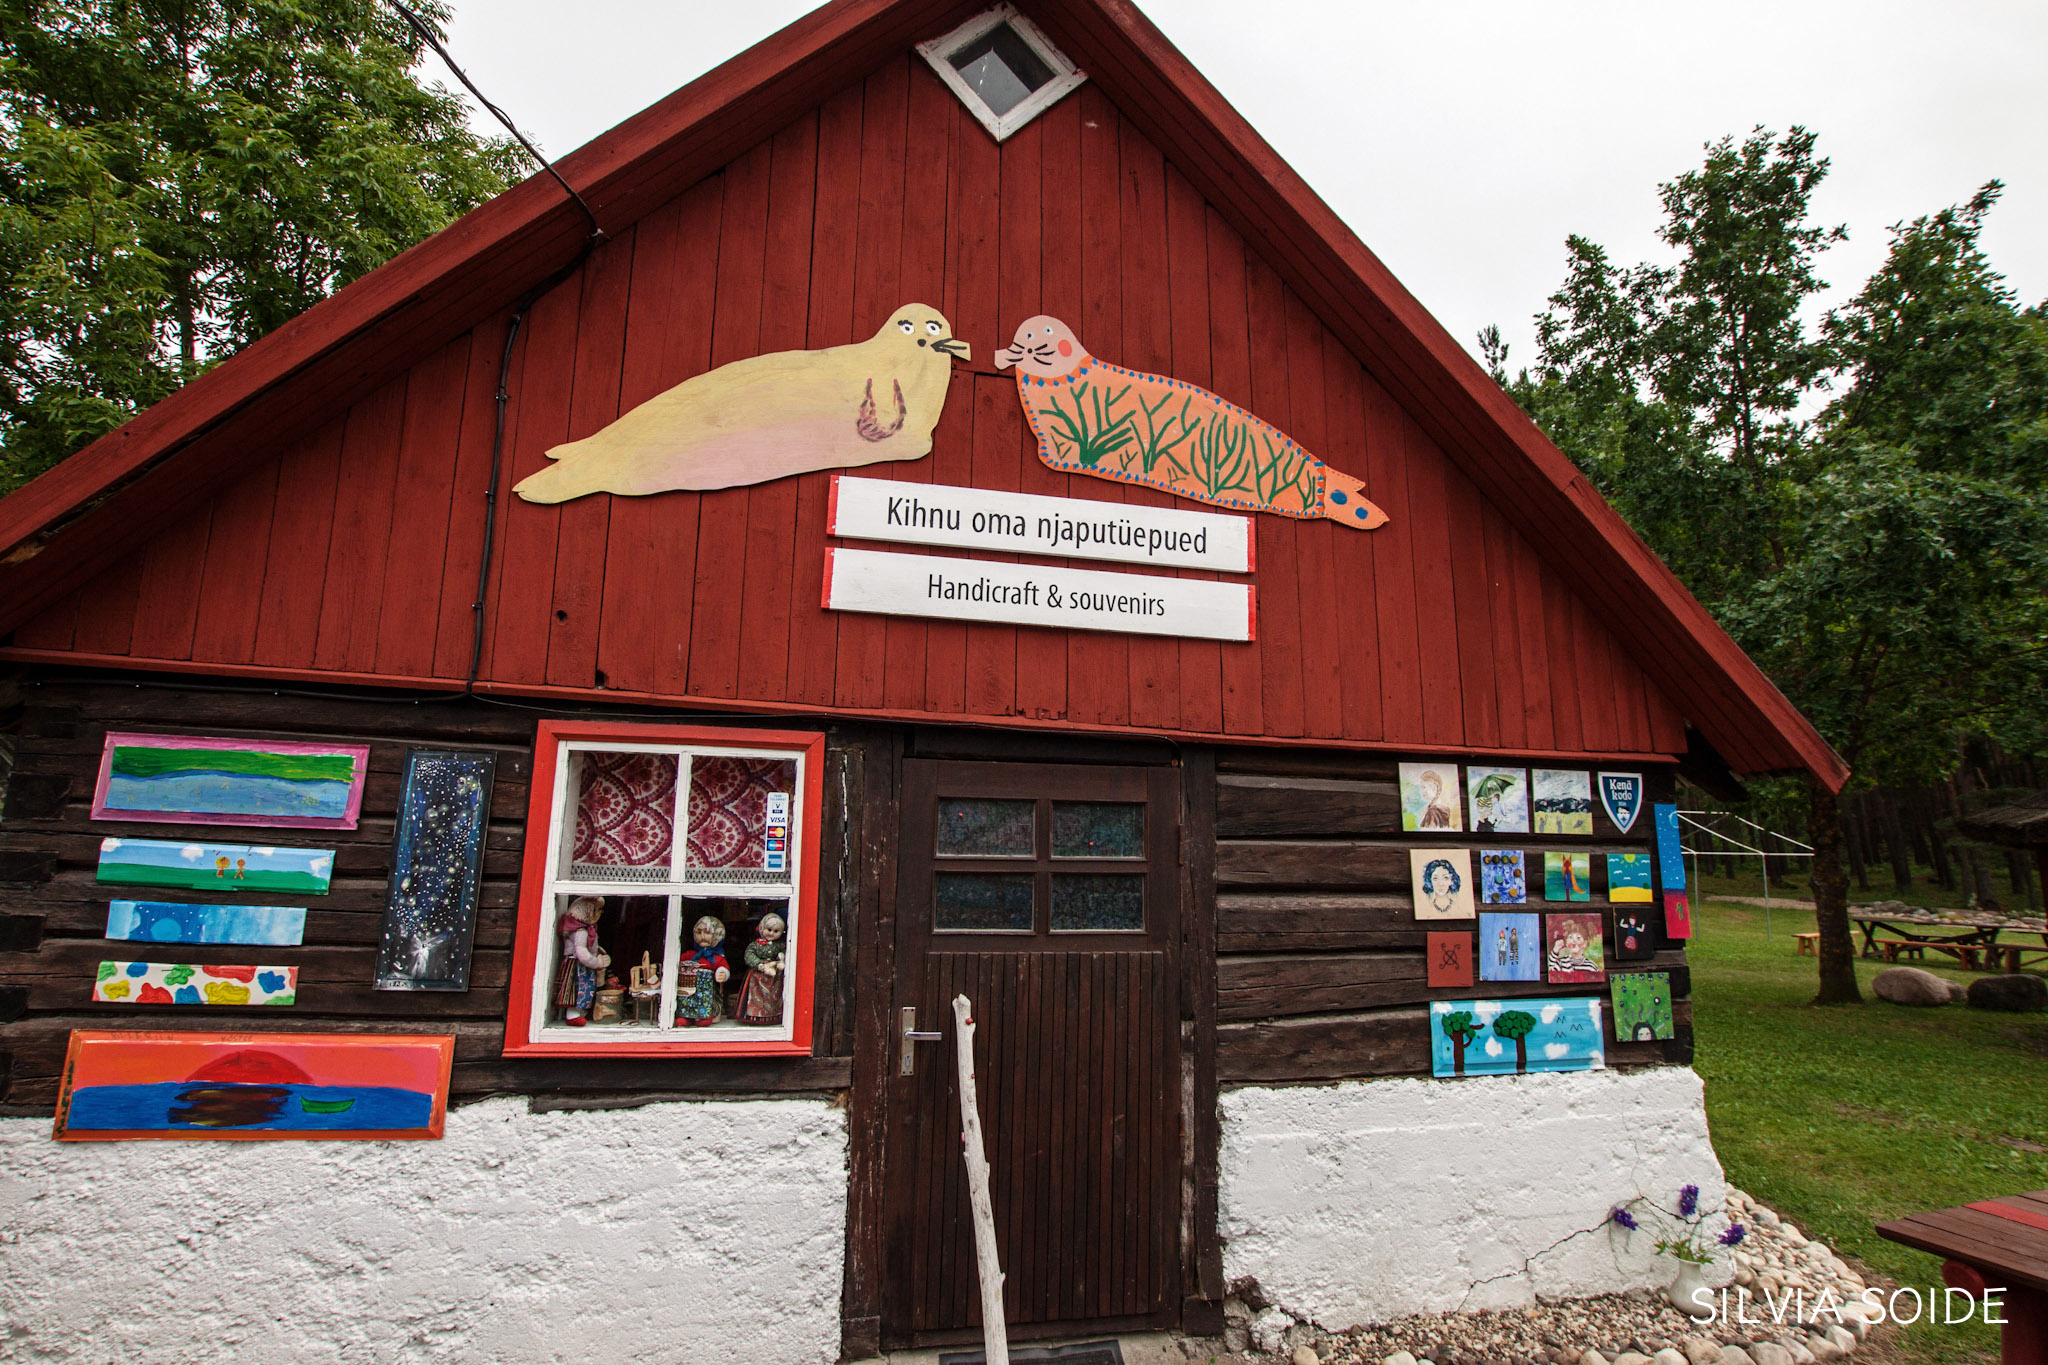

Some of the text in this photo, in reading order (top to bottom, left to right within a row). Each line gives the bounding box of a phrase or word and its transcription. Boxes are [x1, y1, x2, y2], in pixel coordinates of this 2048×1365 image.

[887, 496, 1207, 557] Kihnu oma njaputüepued
[928, 574, 1165, 617] Handicraft & souvenirs
[1612, 789, 1632, 800] kodo
